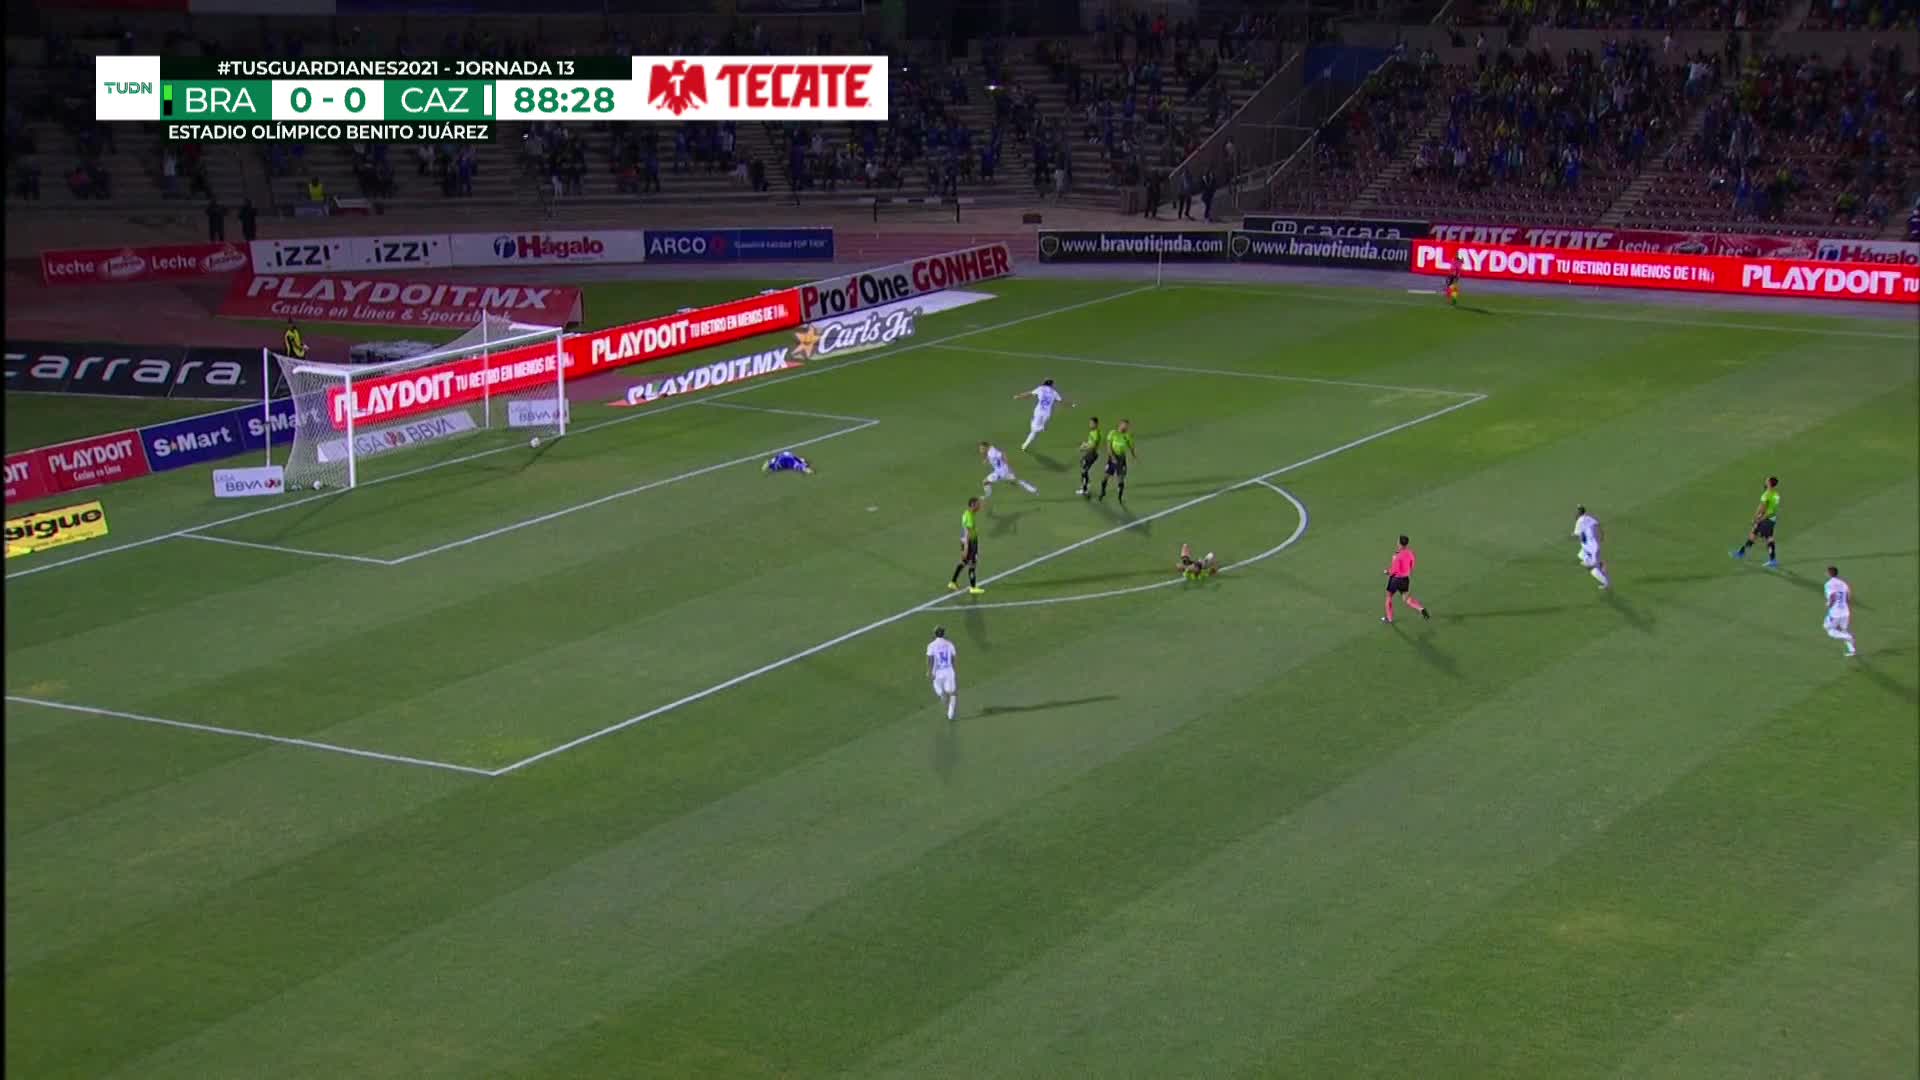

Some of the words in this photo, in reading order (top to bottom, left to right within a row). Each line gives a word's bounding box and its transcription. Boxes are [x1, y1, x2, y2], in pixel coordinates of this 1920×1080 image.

[650, 237, 707, 254] ARCO
[48, 260, 95, 275] Leche
[151, 255, 197, 270] Leche
[912, 246, 1010, 292] GONHER
[1556, 259, 1570, 274] TU
[1572, 260, 1611, 277] RETIRO
[1613, 262, 1629, 277] EN
[1630, 263, 1671, 280] MENOS
[1673, 266, 1689, 281] DE
[1742, 264, 1902, 295] PLAYDOIT
[248, 276, 553, 309] PLAYDOIT.MX
[271, 302, 324, 316] Casino
[329, 307, 349, 317] en
[591, 319, 690, 365] PLAYDOIT
[627, 347, 789, 406] PLAYDOIT.MX
[405, 418, 456, 442] BBVA
[48, 439, 133, 474] PLAYDOIT
[225, 480, 263, 492] BBVA
